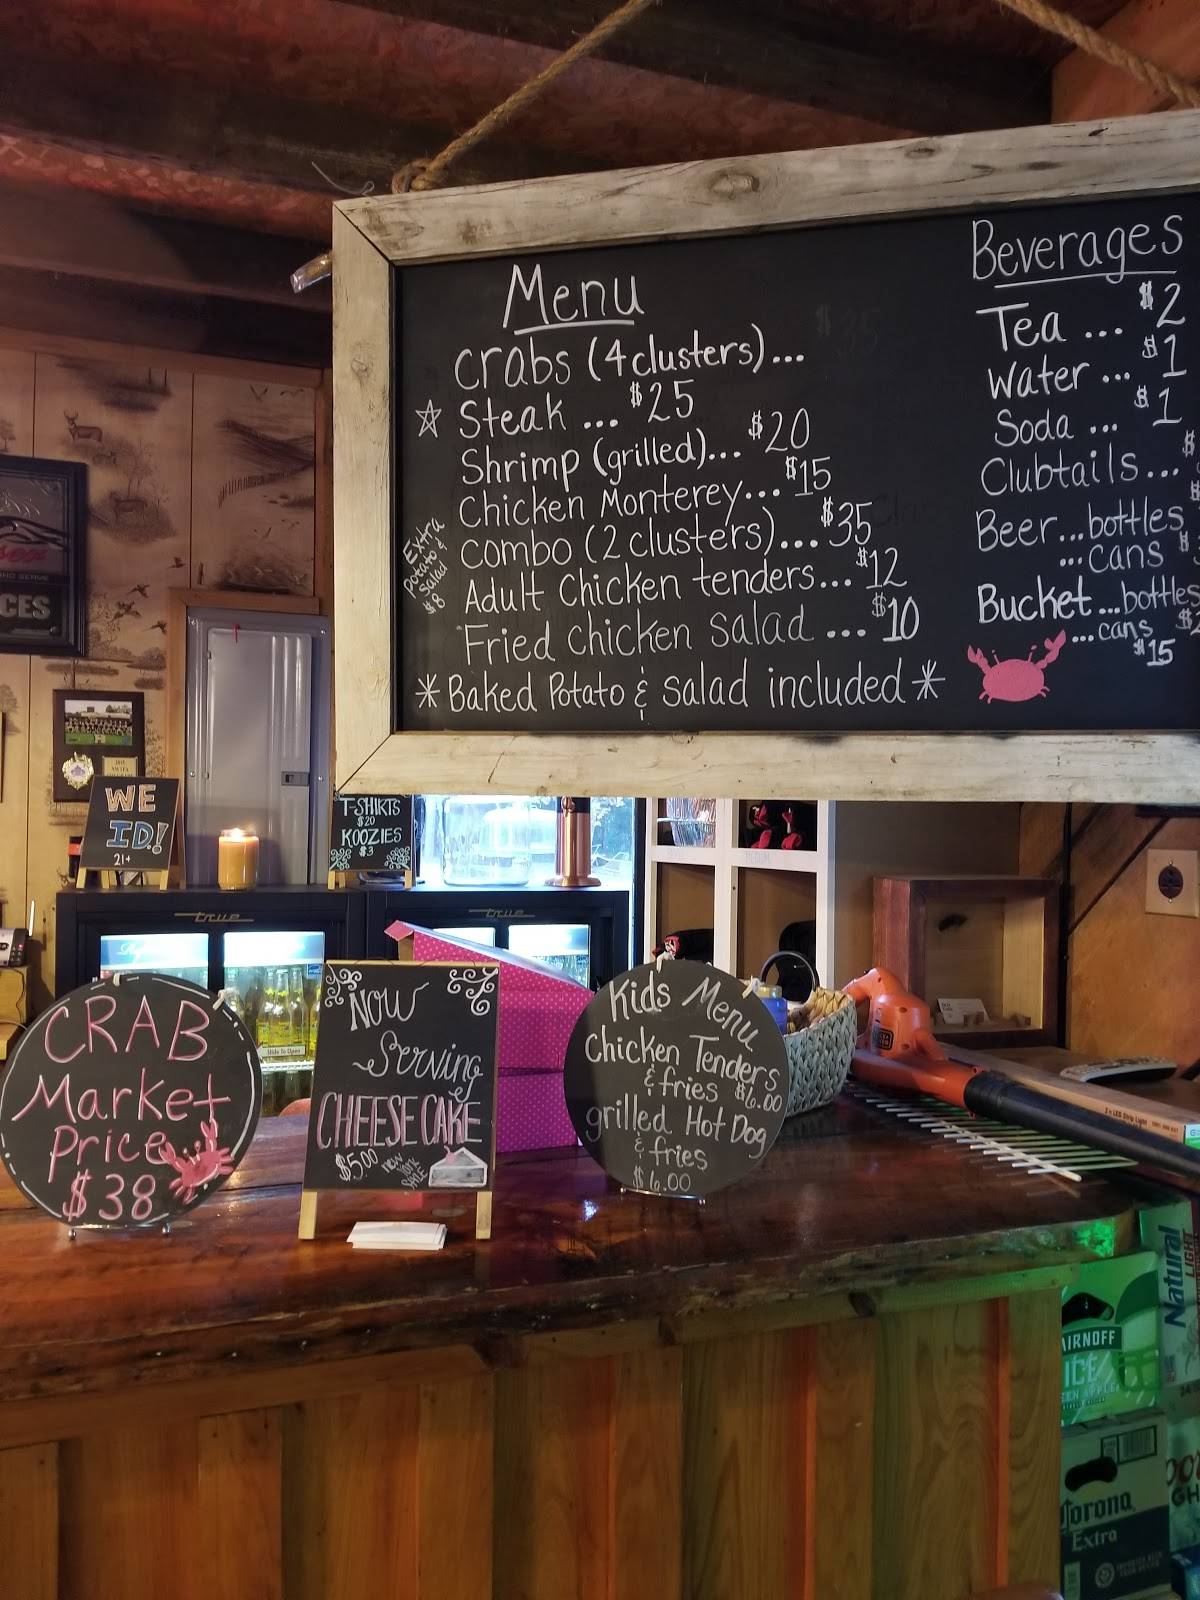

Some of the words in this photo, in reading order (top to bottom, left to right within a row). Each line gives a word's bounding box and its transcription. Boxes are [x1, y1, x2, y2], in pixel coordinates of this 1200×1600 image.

[973, 215, 1183, 284] Beverages
[502, 263, 645, 329] Menu
[976, 302, 1067, 352] Tea
[1139, 281, 1186, 328] $2
[1142, 334, 1187, 378] $1
[460, 392, 567, 439] Steak
[629, 379, 694, 423] $25
[994, 408, 1075, 447] Soda
[1134, 385, 1183, 426] $1
[461, 445, 580, 492] Shrimp
[748, 408, 810, 453] $20
[785, 456, 832, 497] $15
[402, 517, 446, 565] Extra
[821, 496, 873, 547] $35
[976, 508, 1058, 552] Beer
[422, 592, 446, 615] $8
[466, 570, 545, 614] Adult
[856, 547, 908, 589] $12
[977, 574, 1093, 624] Bucket
[464, 620, 556, 666] Fried
[871, 592, 920, 642] $10
[1133, 638, 1176, 667] $15
[449, 670, 538, 712] Baked
[550, 670, 625, 710] Potato
[769, 656, 906, 708] included
[105, 784, 157, 813] WE
[339, 797, 401, 817] T-SHIRTS
[357, 815, 376, 828] $20
[113, 853, 131, 866] 21+
[341, 827, 402, 848] KOOZIES
[359, 846, 374, 857] $3
[608, 969, 672, 1023] Kids
[682, 976, 759, 1052] Menu
[45, 994, 210, 1063] CRAB
[352, 1030, 483, 1103] Serving
[657, 1065, 719, 1103] fries
[735, 1081, 783, 1113] $6.00
[689, 1034, 781, 1092] Tenders
[11, 1067, 231, 1123] Market
[48, 1124, 171, 1183] Price
[648, 1135, 708, 1171] fries
[685, 1104, 726, 1142] Hot
[730, 1113, 767, 1160] Dog
[62, 1169, 156, 1222] $38
[1158, 1224, 1187, 1328] Natural
